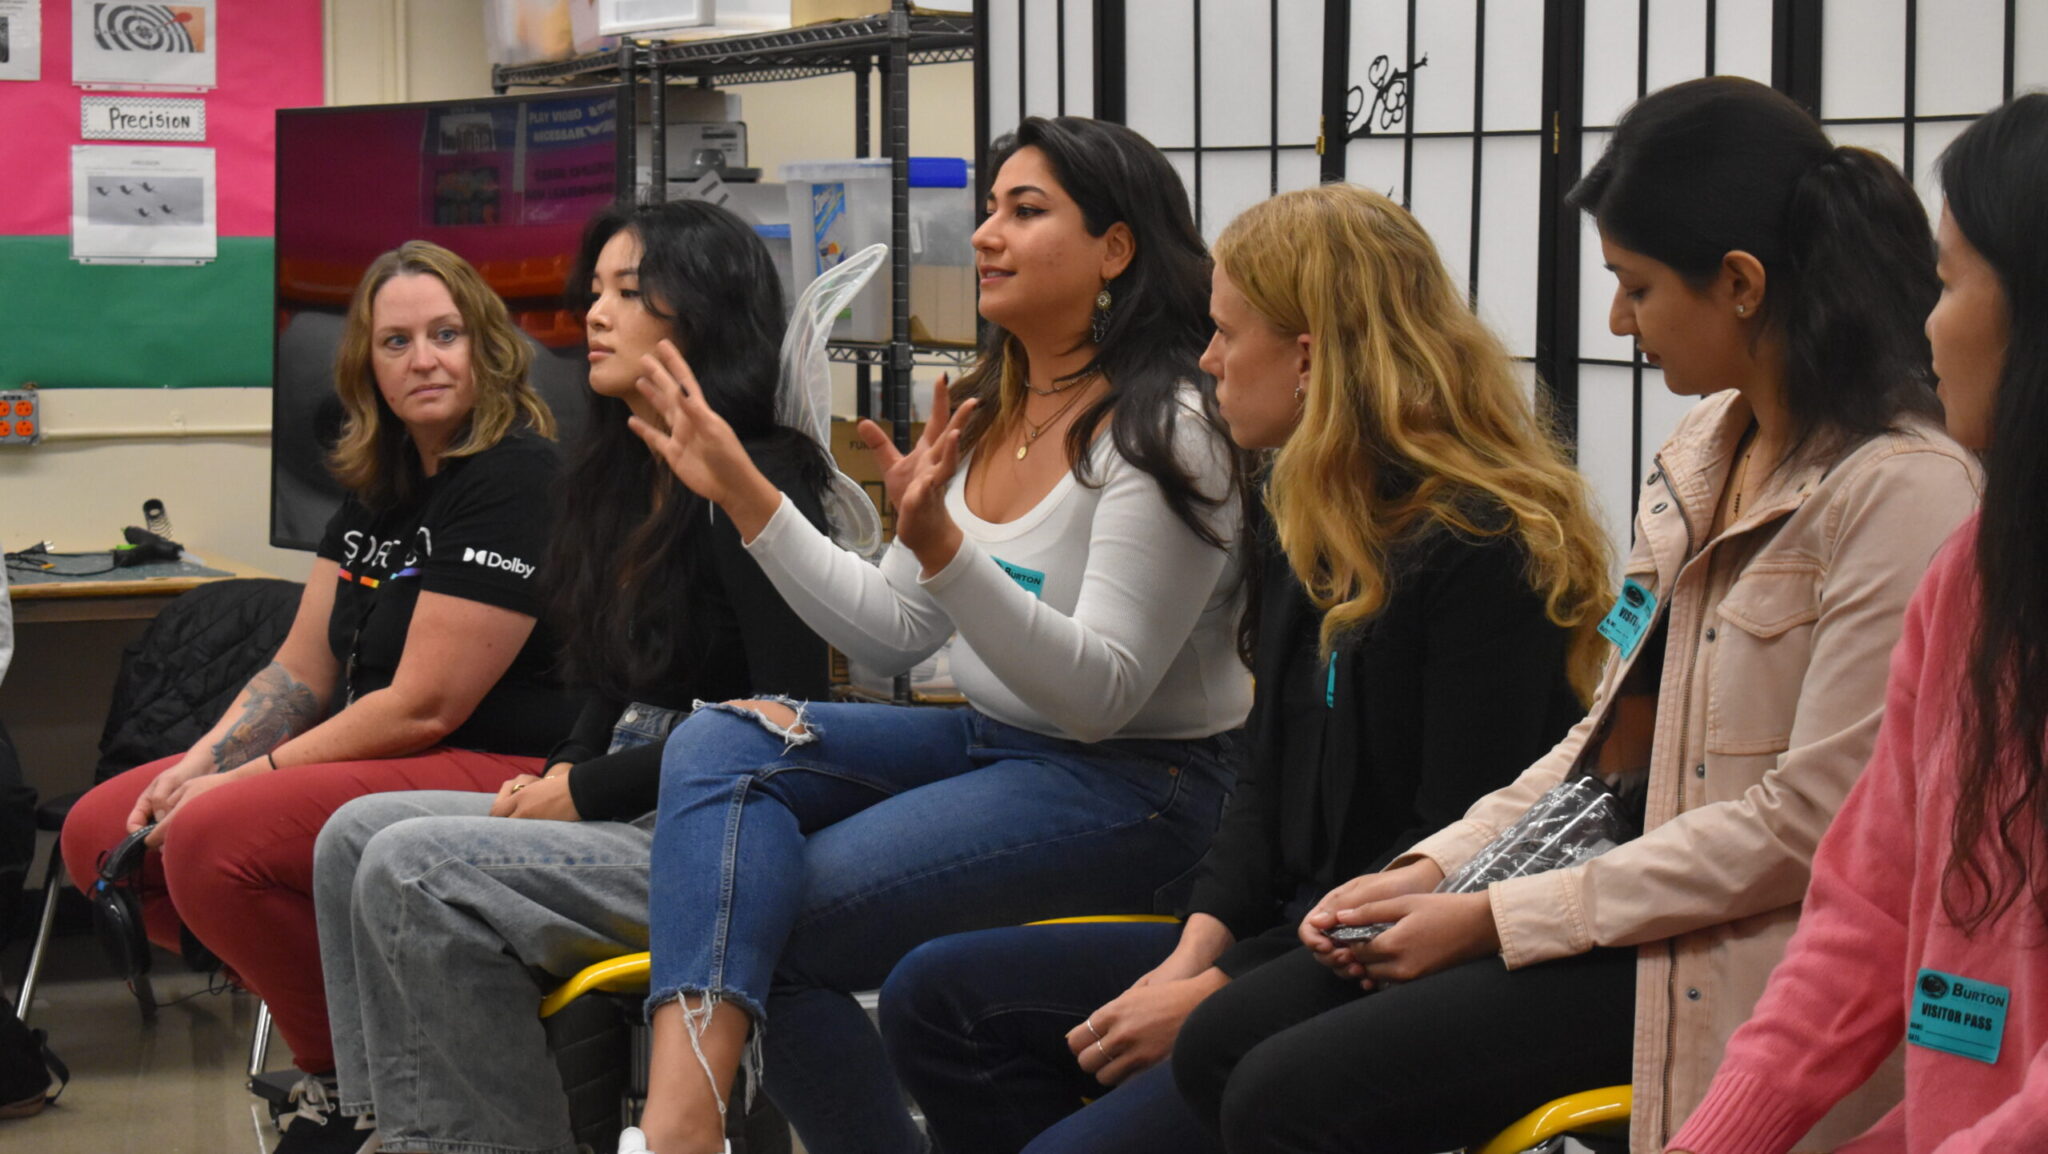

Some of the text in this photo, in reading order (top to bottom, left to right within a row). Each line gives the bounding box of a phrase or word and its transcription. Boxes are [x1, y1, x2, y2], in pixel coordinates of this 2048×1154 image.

[486, 551, 536, 579] Dolby
[1952, 982, 2005, 1007] BURTON
[1921, 1002, 1992, 1031] VISITOR PASS
